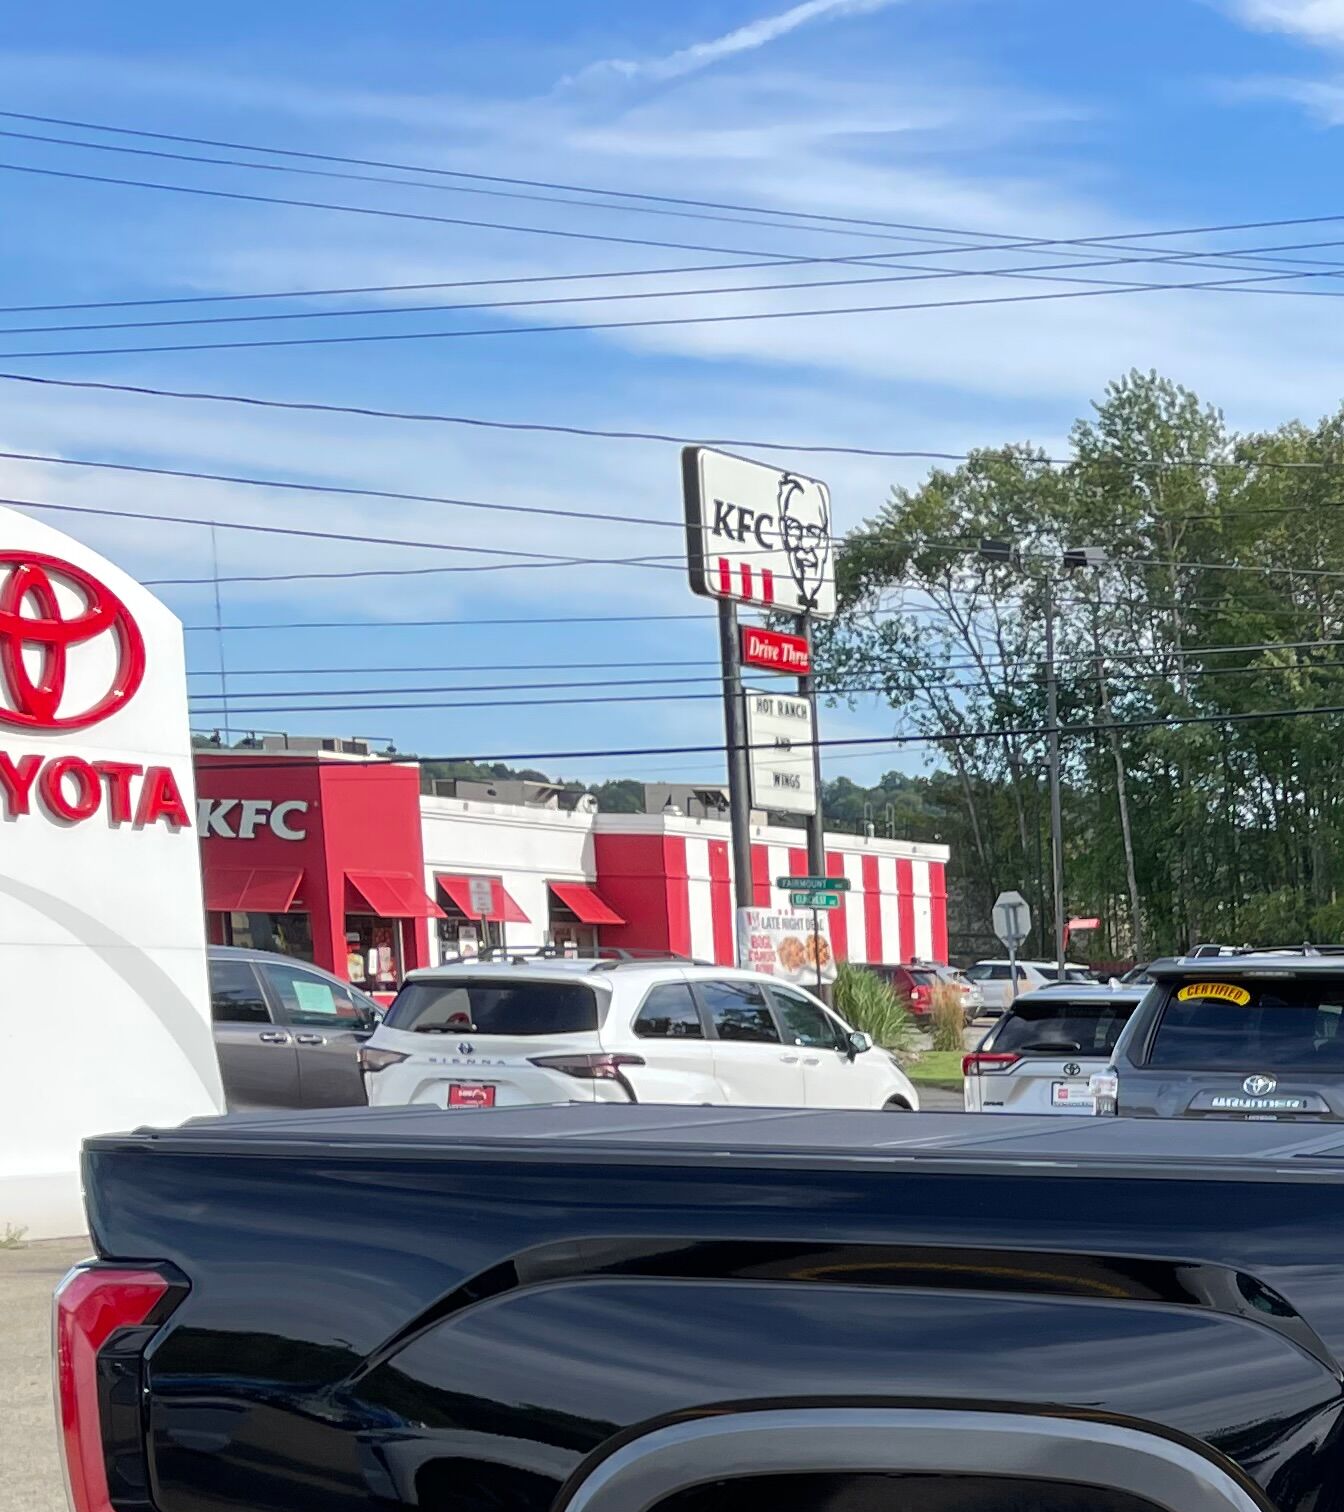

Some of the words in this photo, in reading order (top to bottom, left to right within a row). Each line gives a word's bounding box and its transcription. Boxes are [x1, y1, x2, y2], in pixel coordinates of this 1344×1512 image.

[712, 499, 774, 550] KFC
[749, 635, 780, 662] Drive
[781, 642, 808, 666] Thru
[756, 698, 774, 716] HOT
[777, 700, 808, 720] RANCH
[772, 771, 801, 789] WINGS
[199, 798, 309, 841] KFC
[782, 879, 827, 889] FAIRMOUNT
[761, 916, 781, 930] LATE
[782, 917, 804, 931] NIGHT
[1186, 983, 1244, 1001] CERTIFIED
